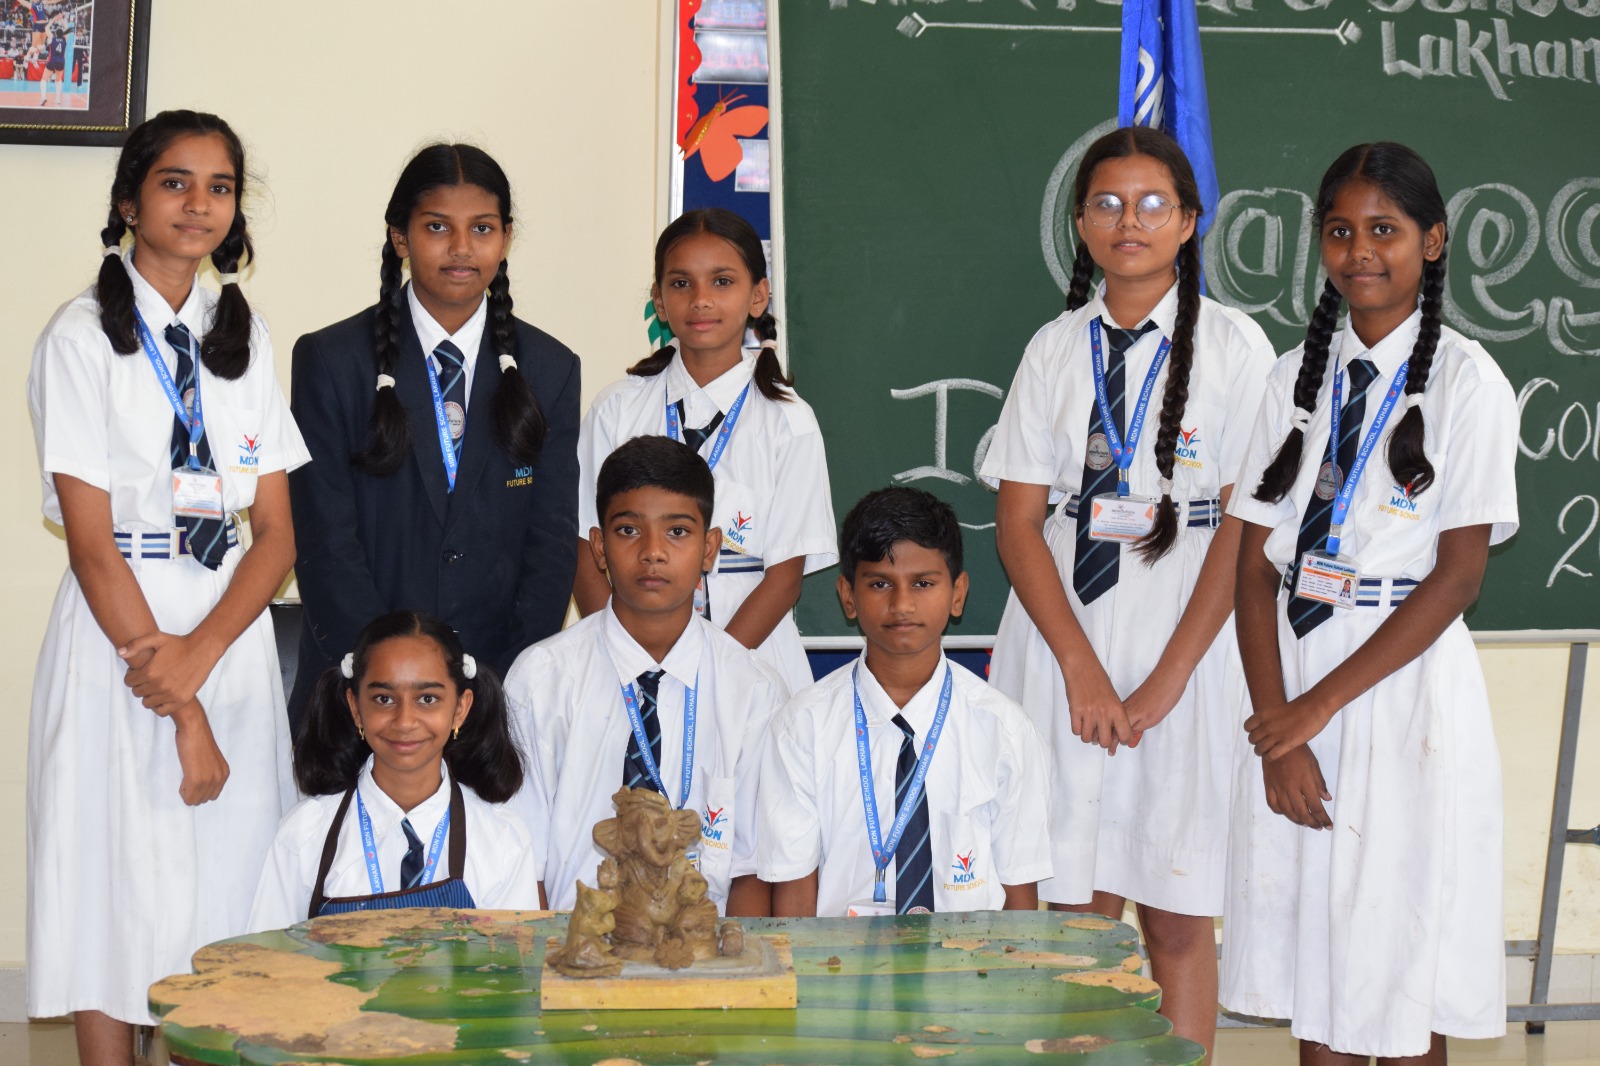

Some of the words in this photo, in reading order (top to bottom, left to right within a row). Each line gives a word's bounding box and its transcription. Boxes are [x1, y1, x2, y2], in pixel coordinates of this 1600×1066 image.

[1152, 349, 1166, 376] LAKHANI
[164, 379, 178, 402] FUTURE
[430, 371, 440, 397] LAKHANI
[1395, 371, 1404, 386] MDN
[174, 402, 184, 415] MDN
[1101, 404, 1112, 429] FUTURE
[1134, 402, 1146, 429] FUTURE
[1516, 377, 1600, 461] Co
[441, 427, 453, 453] FUTURE
[1107, 428, 1118, 444] MDN
[1130, 428, 1139, 442] MDN
[448, 453, 457, 468] MDN
[1343, 483, 1352, 499] MDN
[1349, 457, 1364, 486] FUTURE
[1375, 400, 1392, 430] LAKHANI
[506, 478, 527, 488] FUTURE
[1390, 496, 1417, 512] MDN
[727, 528, 745, 545] MDN
[1547, 495, 1600, 587] 2
[630, 707, 641, 737] LAKHANI
[931, 724, 939, 739] MDN
[936, 699, 948, 723] FUTURE
[859, 740, 867, 771] LAKHANI
[867, 801, 875, 829] FUTURE
[886, 837, 896, 853] MDN
[893, 812, 907, 838] FUTURE
[916, 754, 930, 783] LAKHANI
[365, 831, 373, 847] MDN
[431, 836, 441, 854] MDN
[870, 829, 878, 845] MDN
